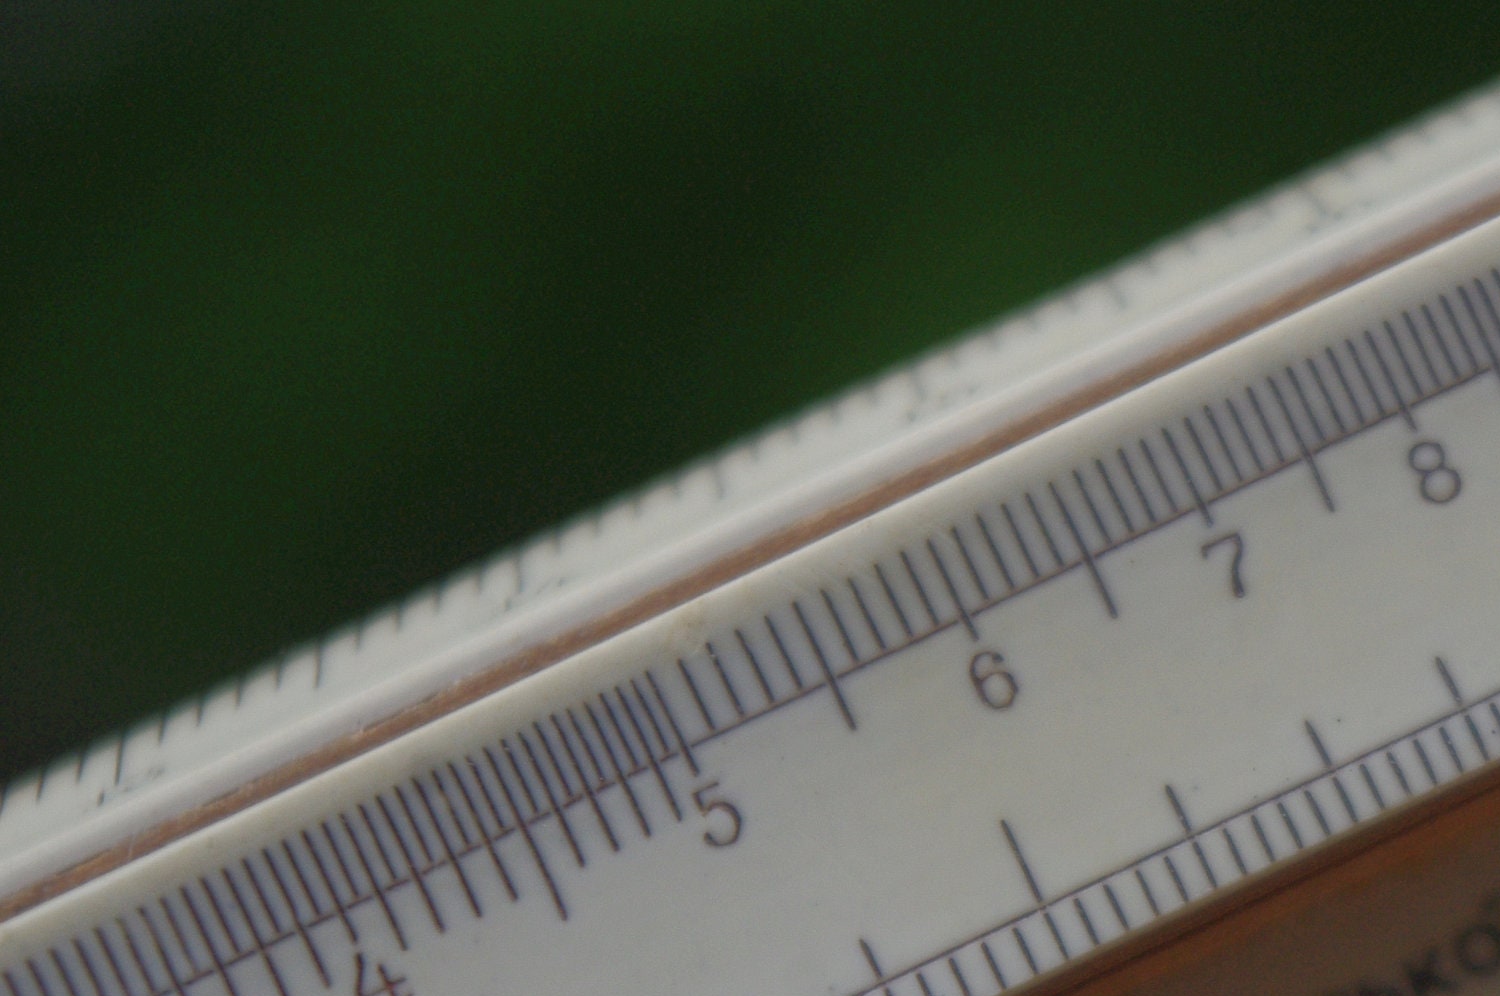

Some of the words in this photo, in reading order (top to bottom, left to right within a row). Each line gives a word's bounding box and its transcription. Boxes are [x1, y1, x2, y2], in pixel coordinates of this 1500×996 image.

[694, 781, 743, 847] 5
[968, 651, 1019, 709] 6
[1201, 533, 1246, 599] 7
[1407, 441, 1462, 503] 8
